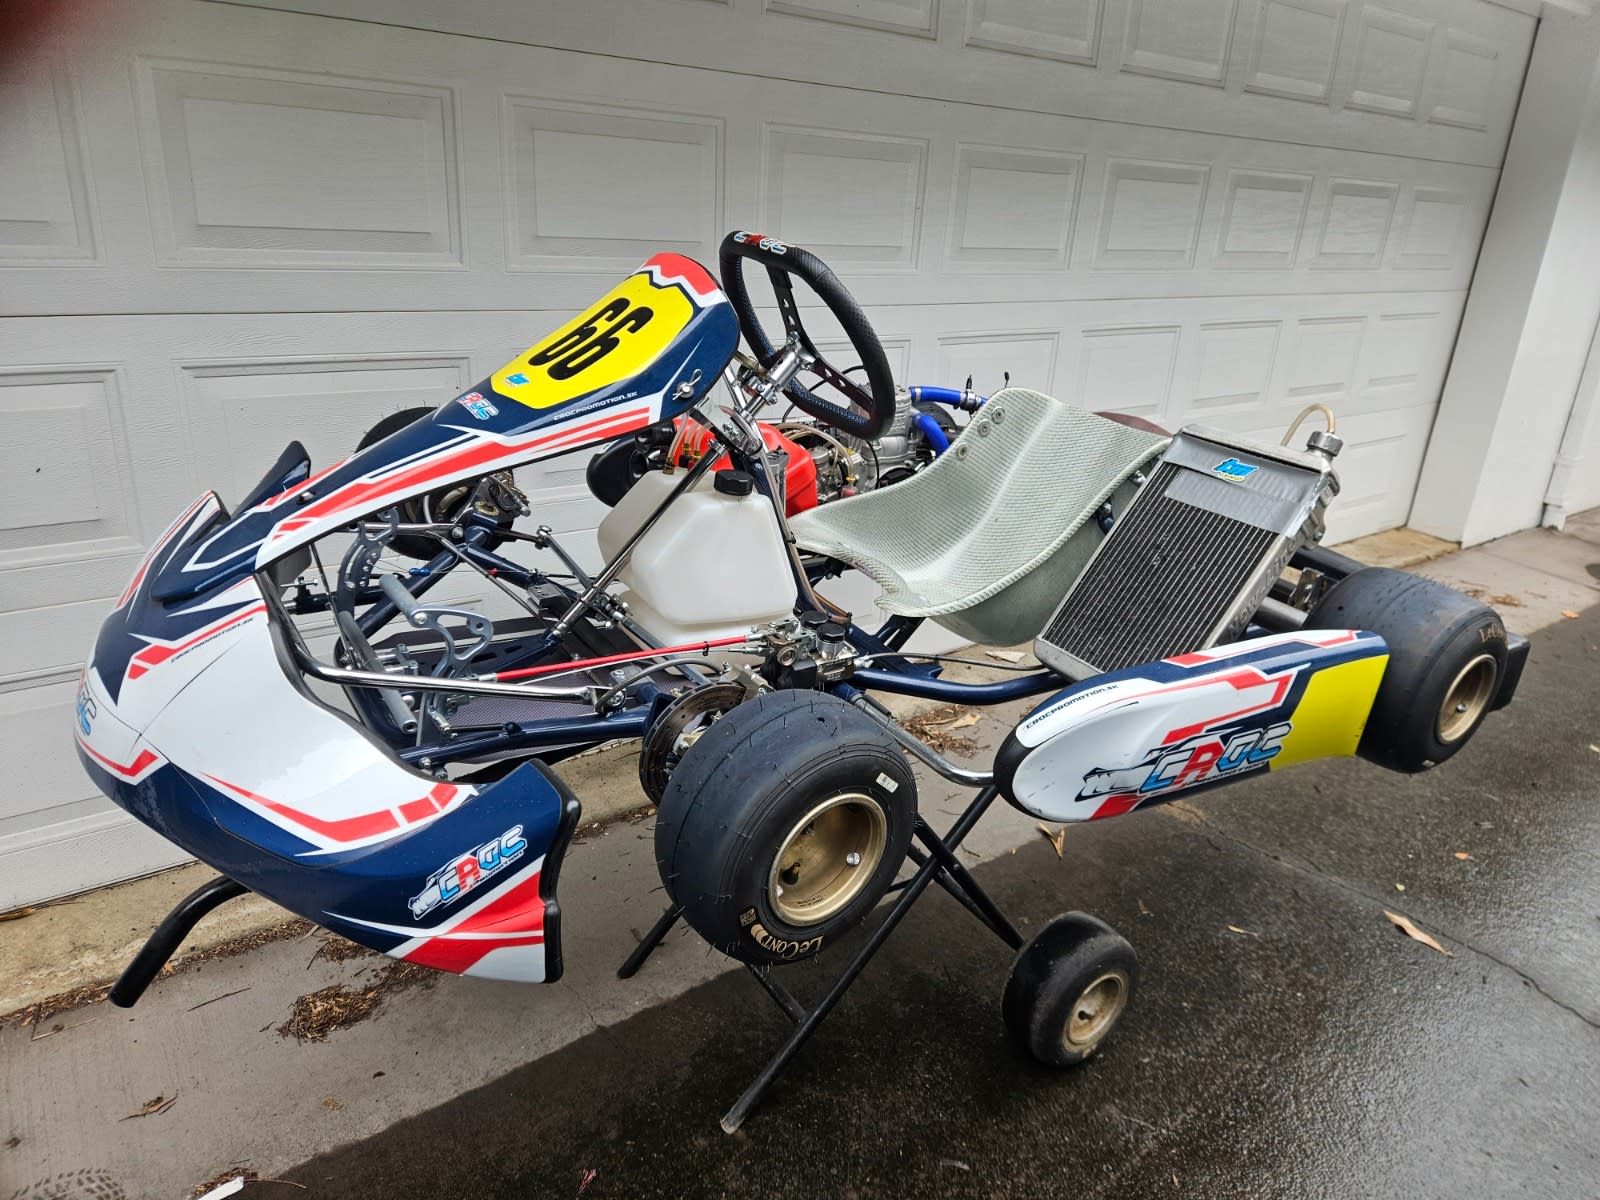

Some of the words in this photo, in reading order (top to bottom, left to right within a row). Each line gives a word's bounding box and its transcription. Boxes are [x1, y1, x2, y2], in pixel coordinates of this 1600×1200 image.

[527, 297, 654, 381] 66
[1025, 684, 1119, 729] CROCPROMOTION.SK
[1138, 721, 1293, 793] CROC
[438, 824, 528, 902] CROC
